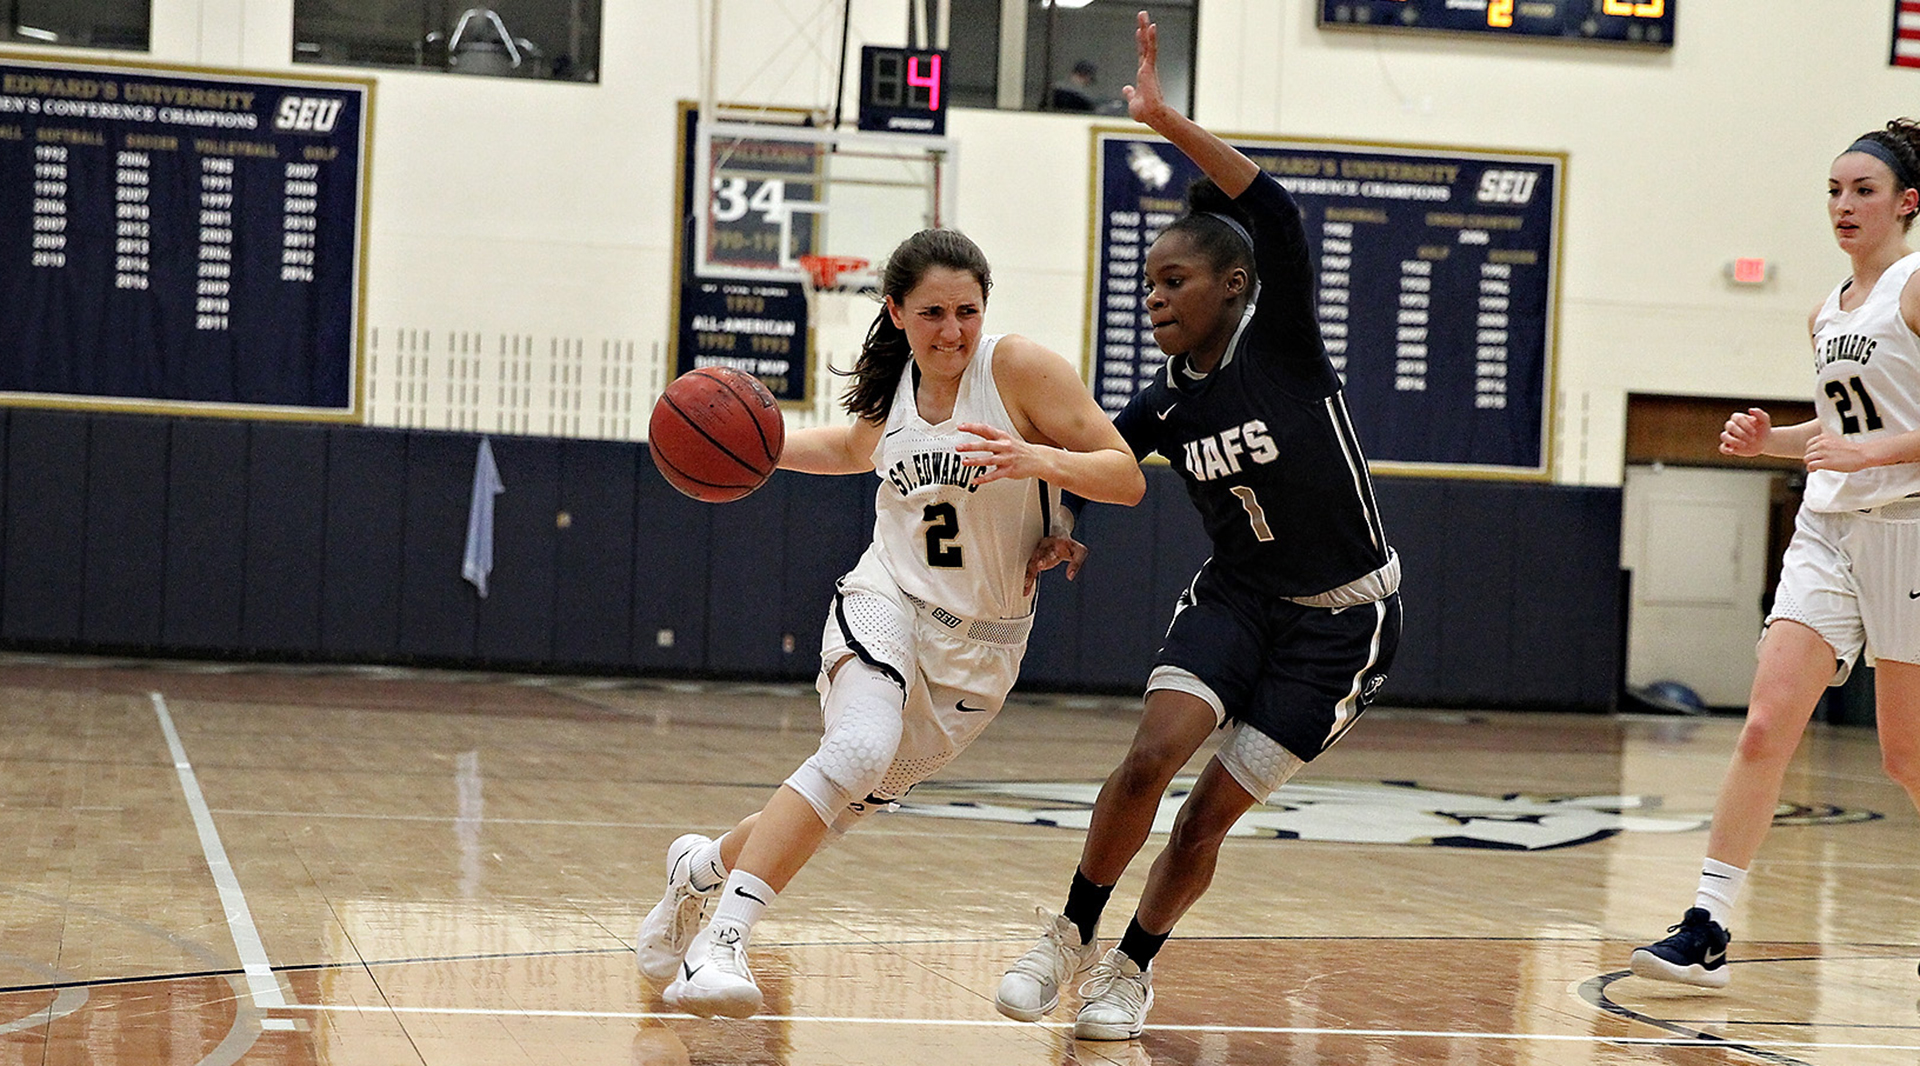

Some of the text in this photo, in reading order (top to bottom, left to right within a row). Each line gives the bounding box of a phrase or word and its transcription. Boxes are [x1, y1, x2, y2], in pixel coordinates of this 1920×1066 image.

[907, 54, 941, 111] 4
[3, 74, 256, 111] EDWARD'S UNIVERSITY
[42, 98, 157, 123] CONFERENCE
[158, 106, 259, 131] CHAMPIONS
[276, 96, 342, 132] SEU
[125, 133, 179, 151] SOCCER
[193, 138, 280, 159] VOLLEYBALL
[35, 145, 68, 162] 1992
[284, 162, 319, 179] 2007
[1250, 154, 1337, 177] WARD'S
[201, 174, 233, 192] 1991
[1360, 181, 1451, 202] CHAMPIONS
[1477, 169, 1539, 204] SEU
[115, 185, 150, 203] 2007
[200, 192, 233, 209] 1997
[712, 177, 786, 223] 34
[116, 202, 150, 220] 2010
[199, 209, 232, 226] 2001
[33, 215, 68, 232] 2007
[116, 220, 150, 238] 2012
[283, 214, 317, 232] 2010
[283, 231, 316, 248] 2011
[31, 251, 66, 268] 2010
[281, 248, 315, 266] 2012
[196, 296, 230, 314] 2010
[196, 314, 229, 330] 2011
[692, 315, 796, 337] ALL-AMERICAN
[1826, 333, 1878, 366] EDWARD'S
[757, 359, 790, 376] MVP
[1825, 376, 1884, 435] 21
[1183, 419, 1281, 481] UAFS
[889, 460, 917, 497] ST.
[1230, 485, 1275, 542] 1
[922, 501, 965, 571] 2
[931, 606, 964, 629] SEU
